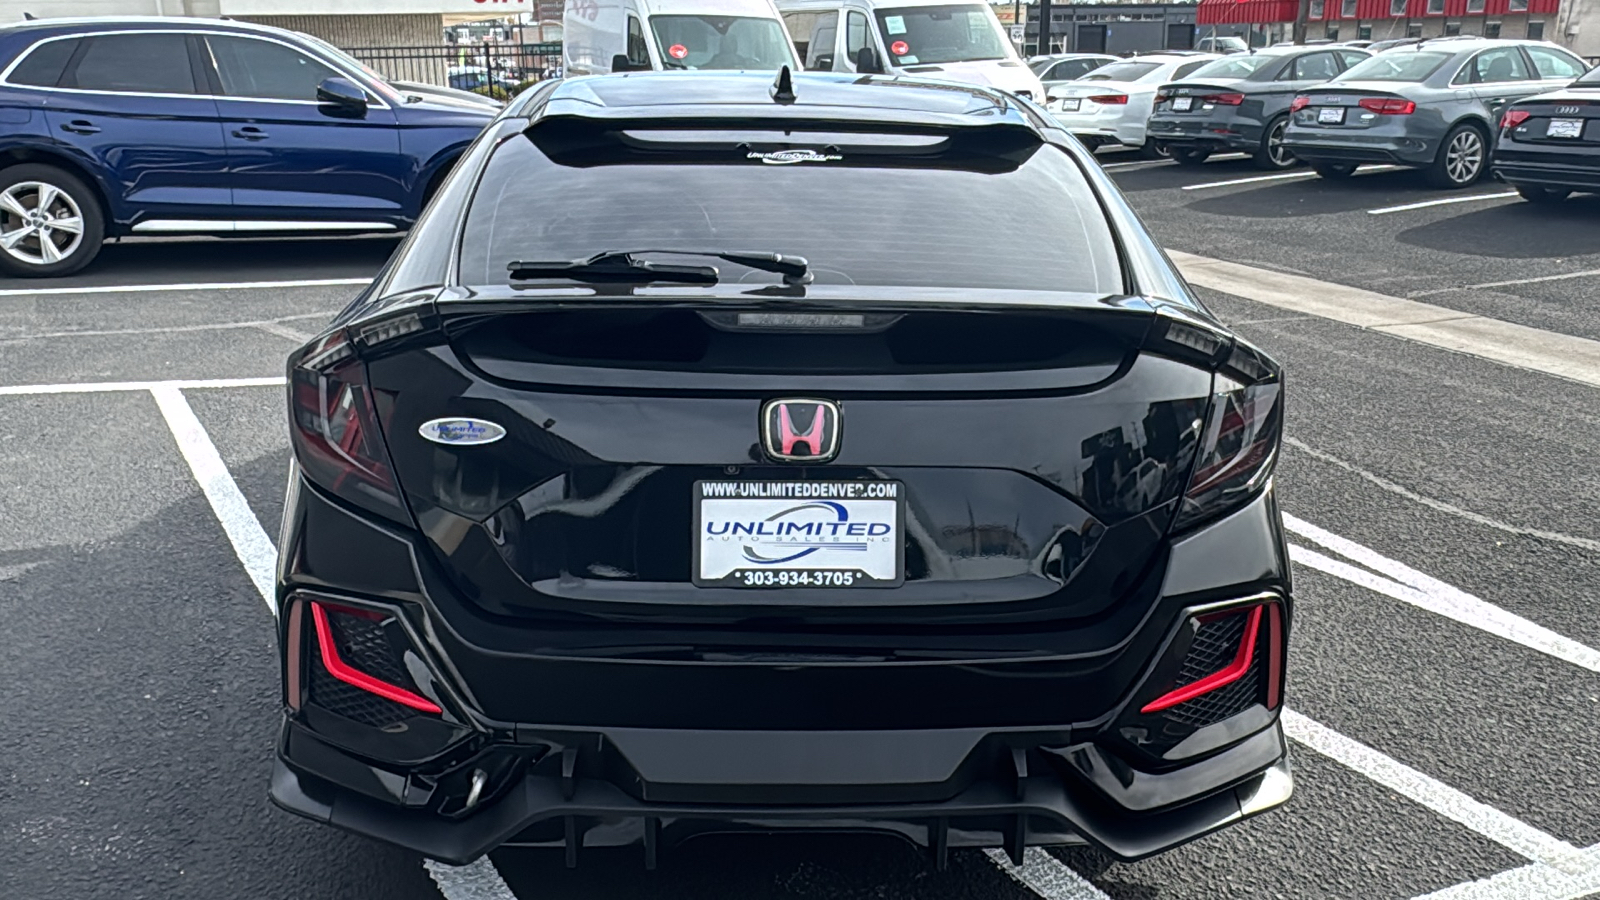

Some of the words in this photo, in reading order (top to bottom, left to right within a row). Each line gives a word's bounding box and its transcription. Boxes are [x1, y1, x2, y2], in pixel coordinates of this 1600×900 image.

[702, 482, 897, 497] WWWUNLIMITEDDENVER.COM
[706, 522, 891, 536] UNLIMITED
[744, 571, 853, 586] 303-934-3705
